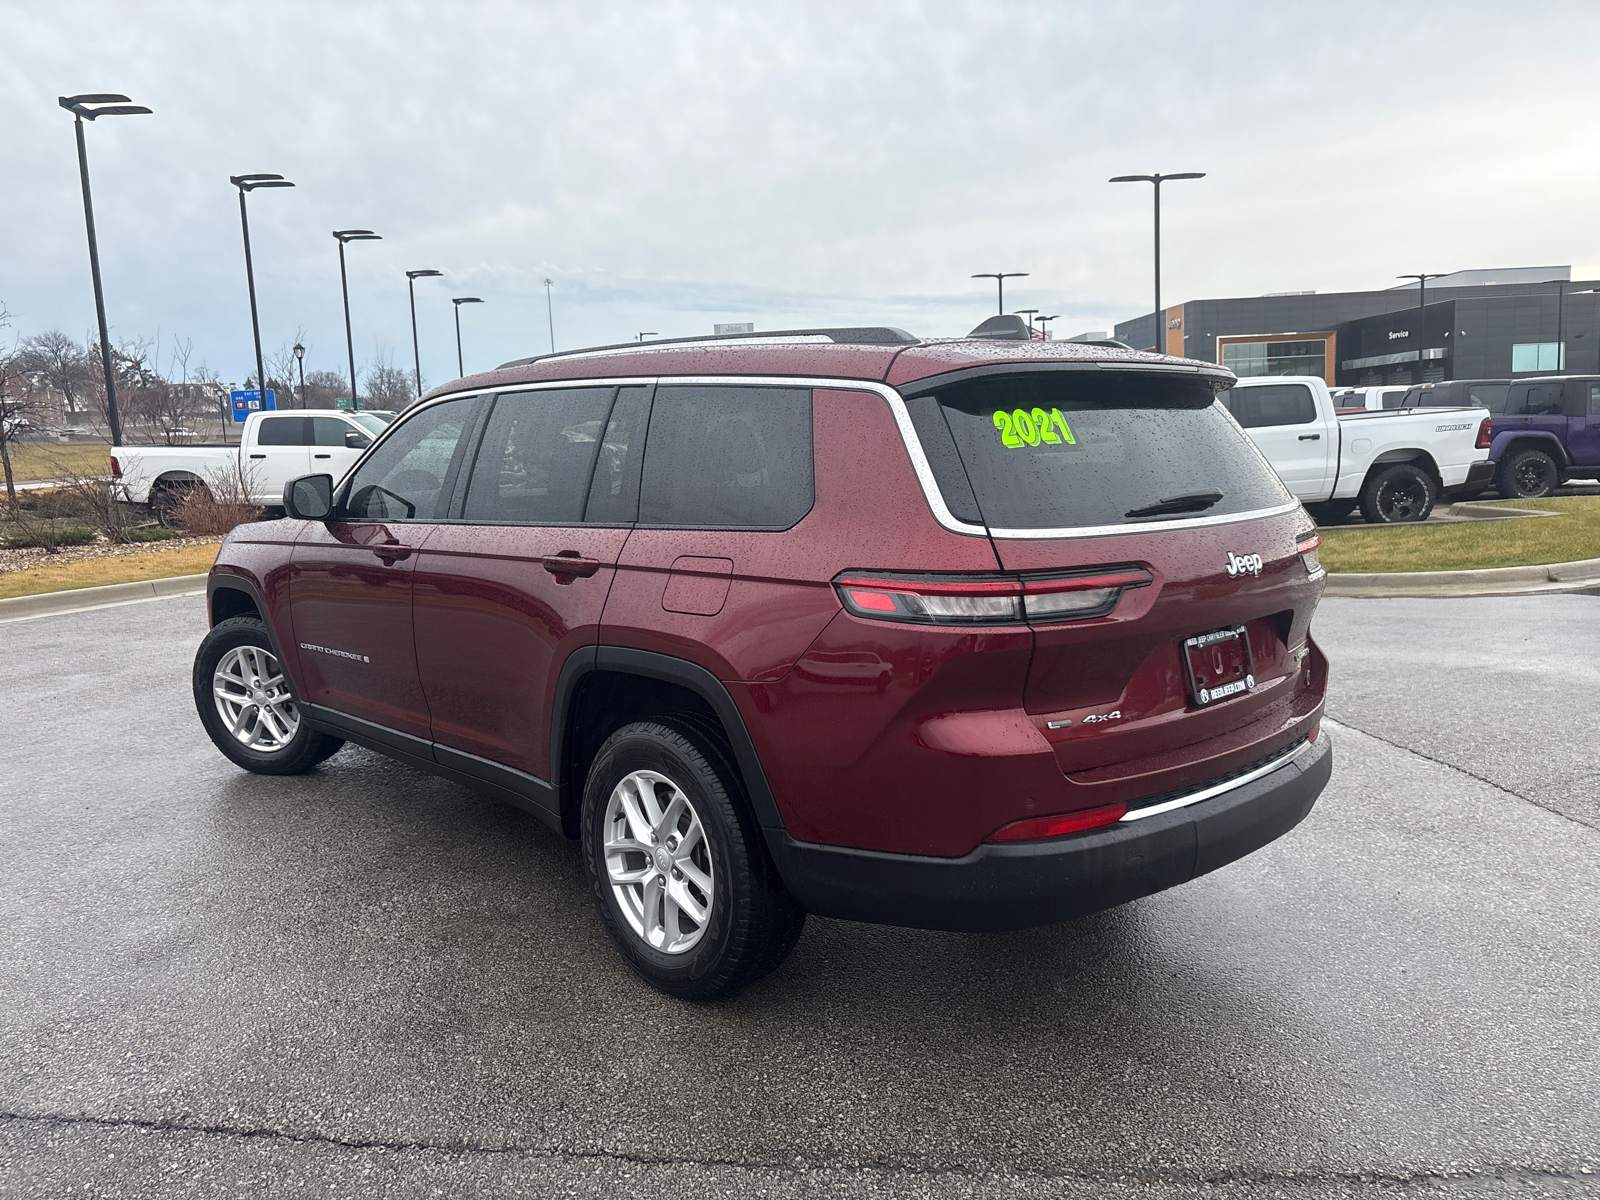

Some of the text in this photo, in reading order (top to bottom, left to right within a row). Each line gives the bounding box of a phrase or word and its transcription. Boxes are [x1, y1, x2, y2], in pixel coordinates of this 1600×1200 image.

[1389, 330, 1409, 340] Service
[993, 407, 1076, 449] 2021
[1435, 423, 1473, 432] WARLOCK
[1225, 551, 1263, 577] Jeep
[300, 642, 324, 653] GRAND
[324, 647, 363, 662] CHEROKEE
[1210, 680, 1247, 700] REEDJEEP.COM
[1082, 710, 1121, 723] 4x4
